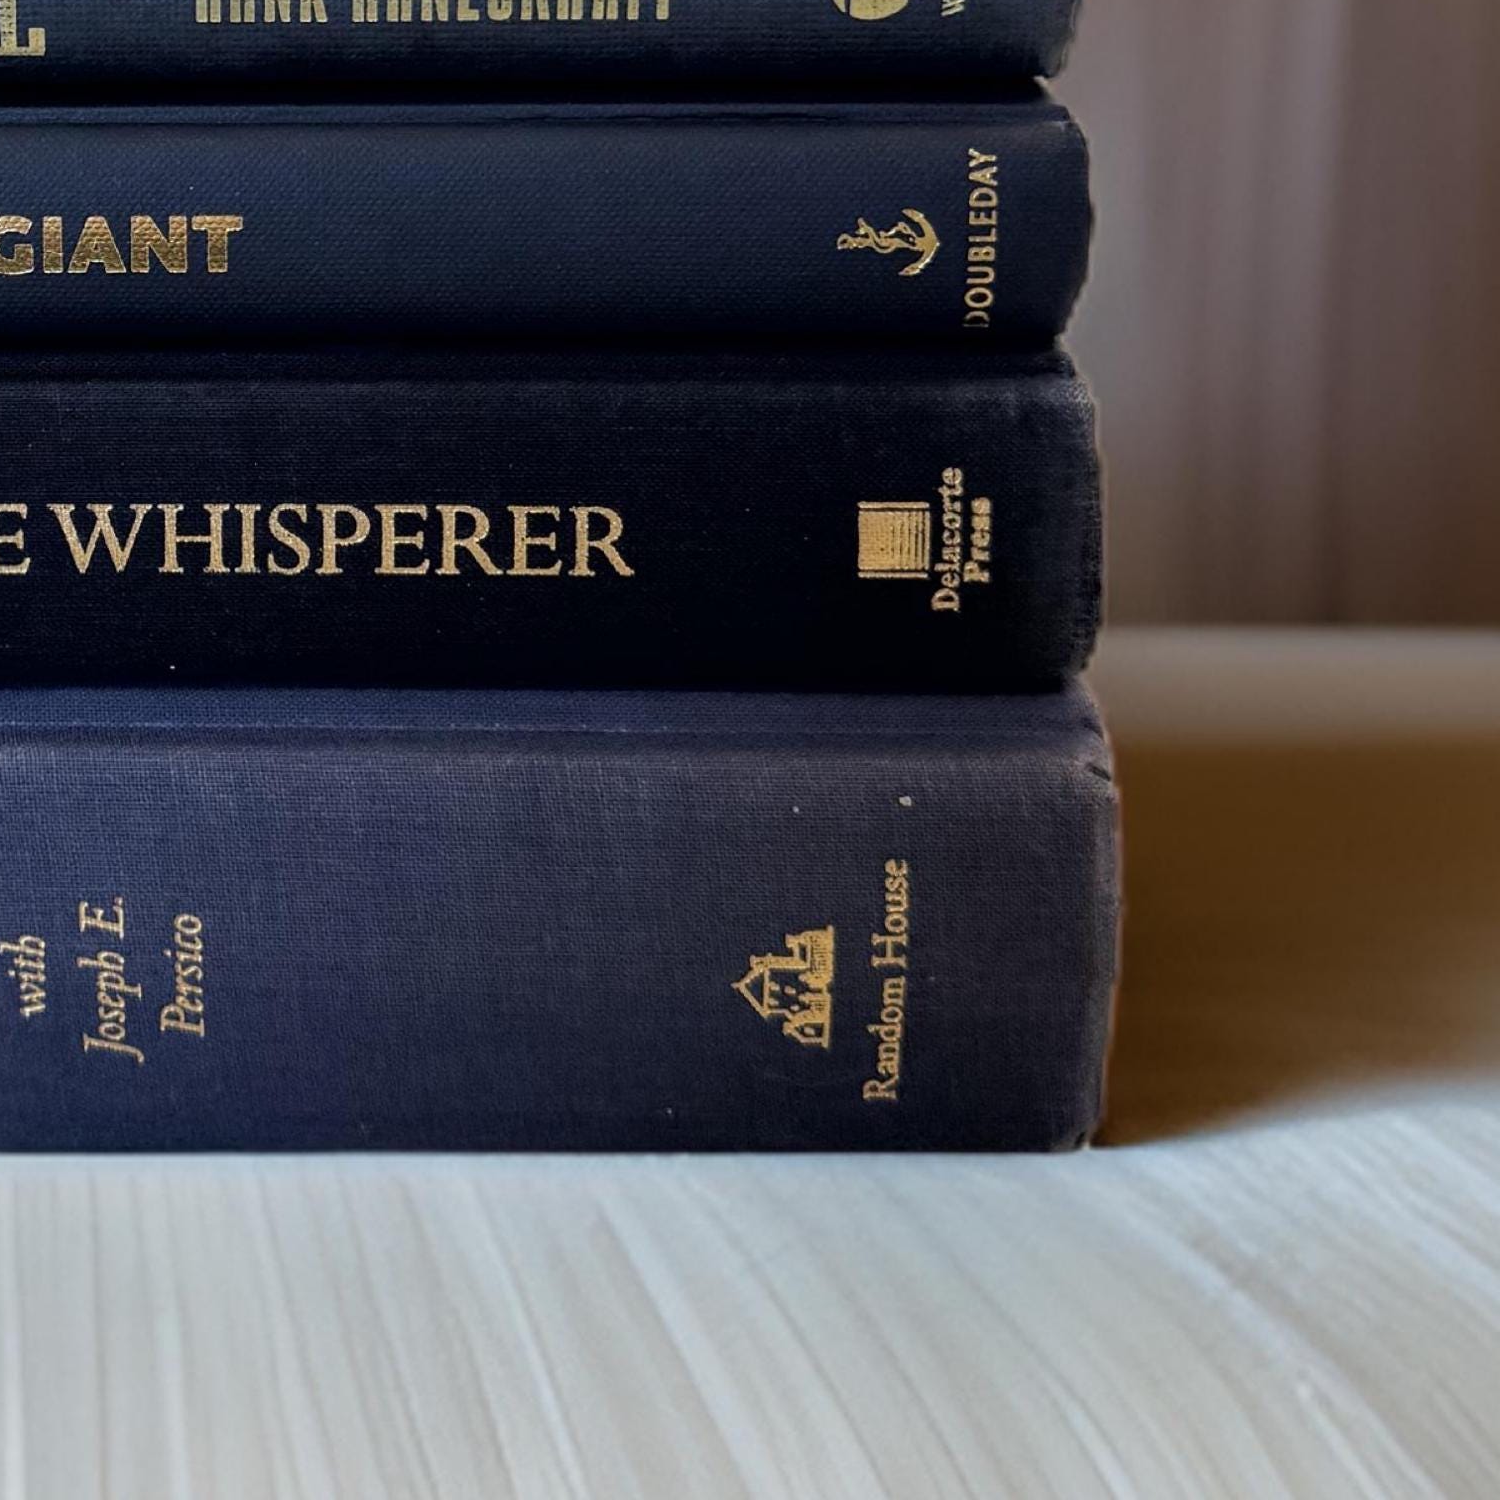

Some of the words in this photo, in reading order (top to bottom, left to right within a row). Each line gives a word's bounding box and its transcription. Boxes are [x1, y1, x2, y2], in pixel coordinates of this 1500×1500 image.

[963, 148, 999, 328] DOUBLEDAY
[47, 501, 635, 578] WHISPERER
[931, 467, 964, 613] Delacorte
[78, 896, 125, 939] E.
[871, 858, 910, 969] House
[76, 950, 145, 1067] Joseph
[159, 912, 205, 1037] Persico
[862, 975, 908, 1101] Random
